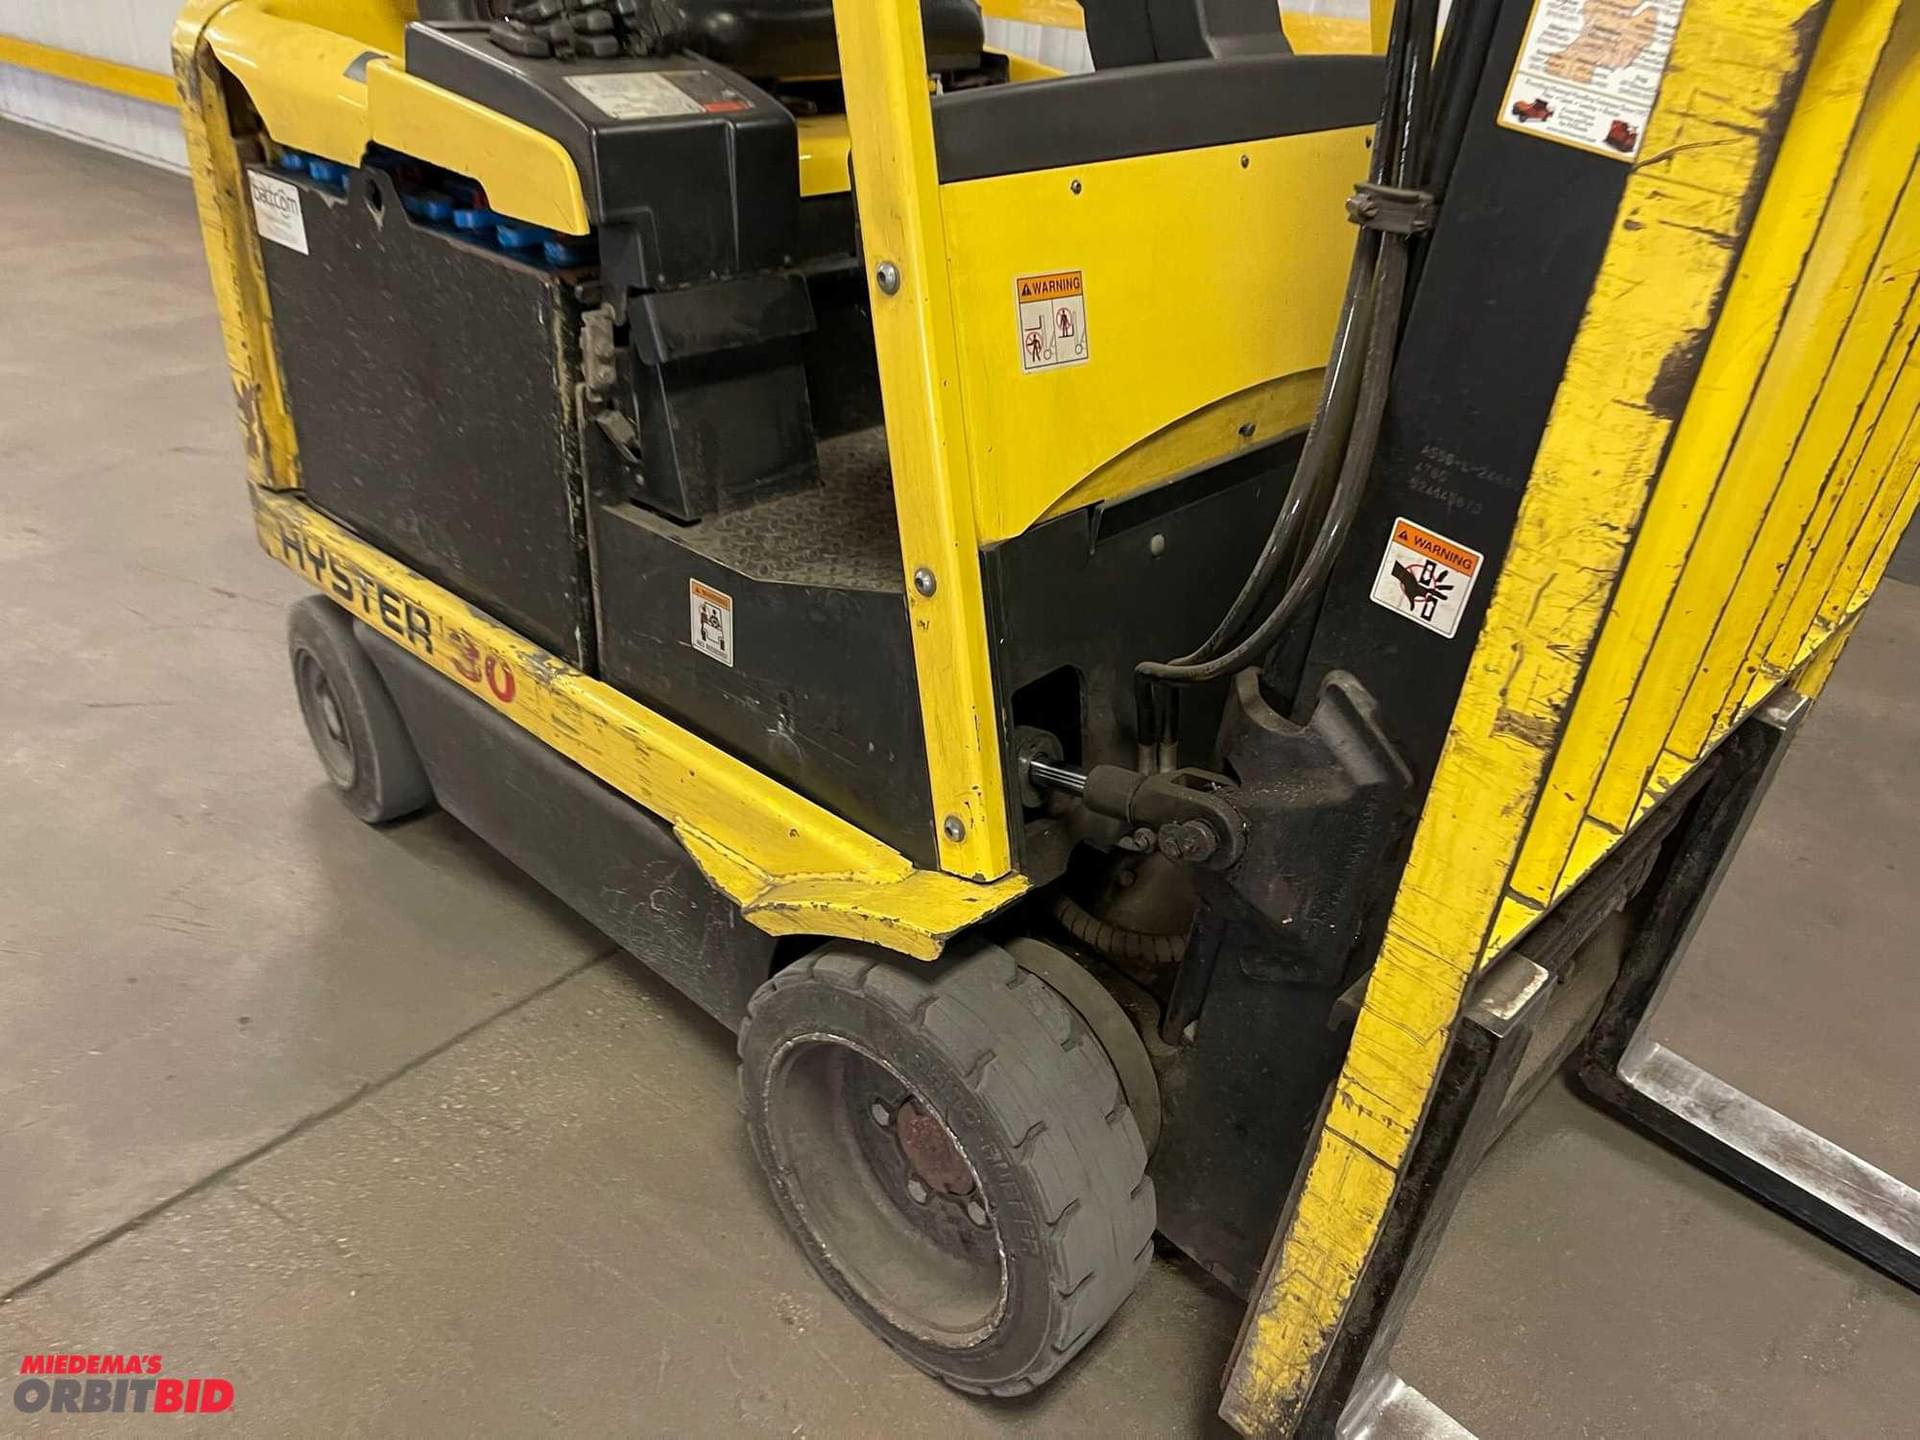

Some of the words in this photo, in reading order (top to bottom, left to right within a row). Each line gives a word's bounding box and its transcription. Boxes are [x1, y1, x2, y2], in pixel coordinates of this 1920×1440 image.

[1032, 277, 1081, 295] WARNING
[1414, 535, 1474, 571] WARNING
[280, 526, 434, 656] HYSTER
[449, 627, 517, 704] 30
